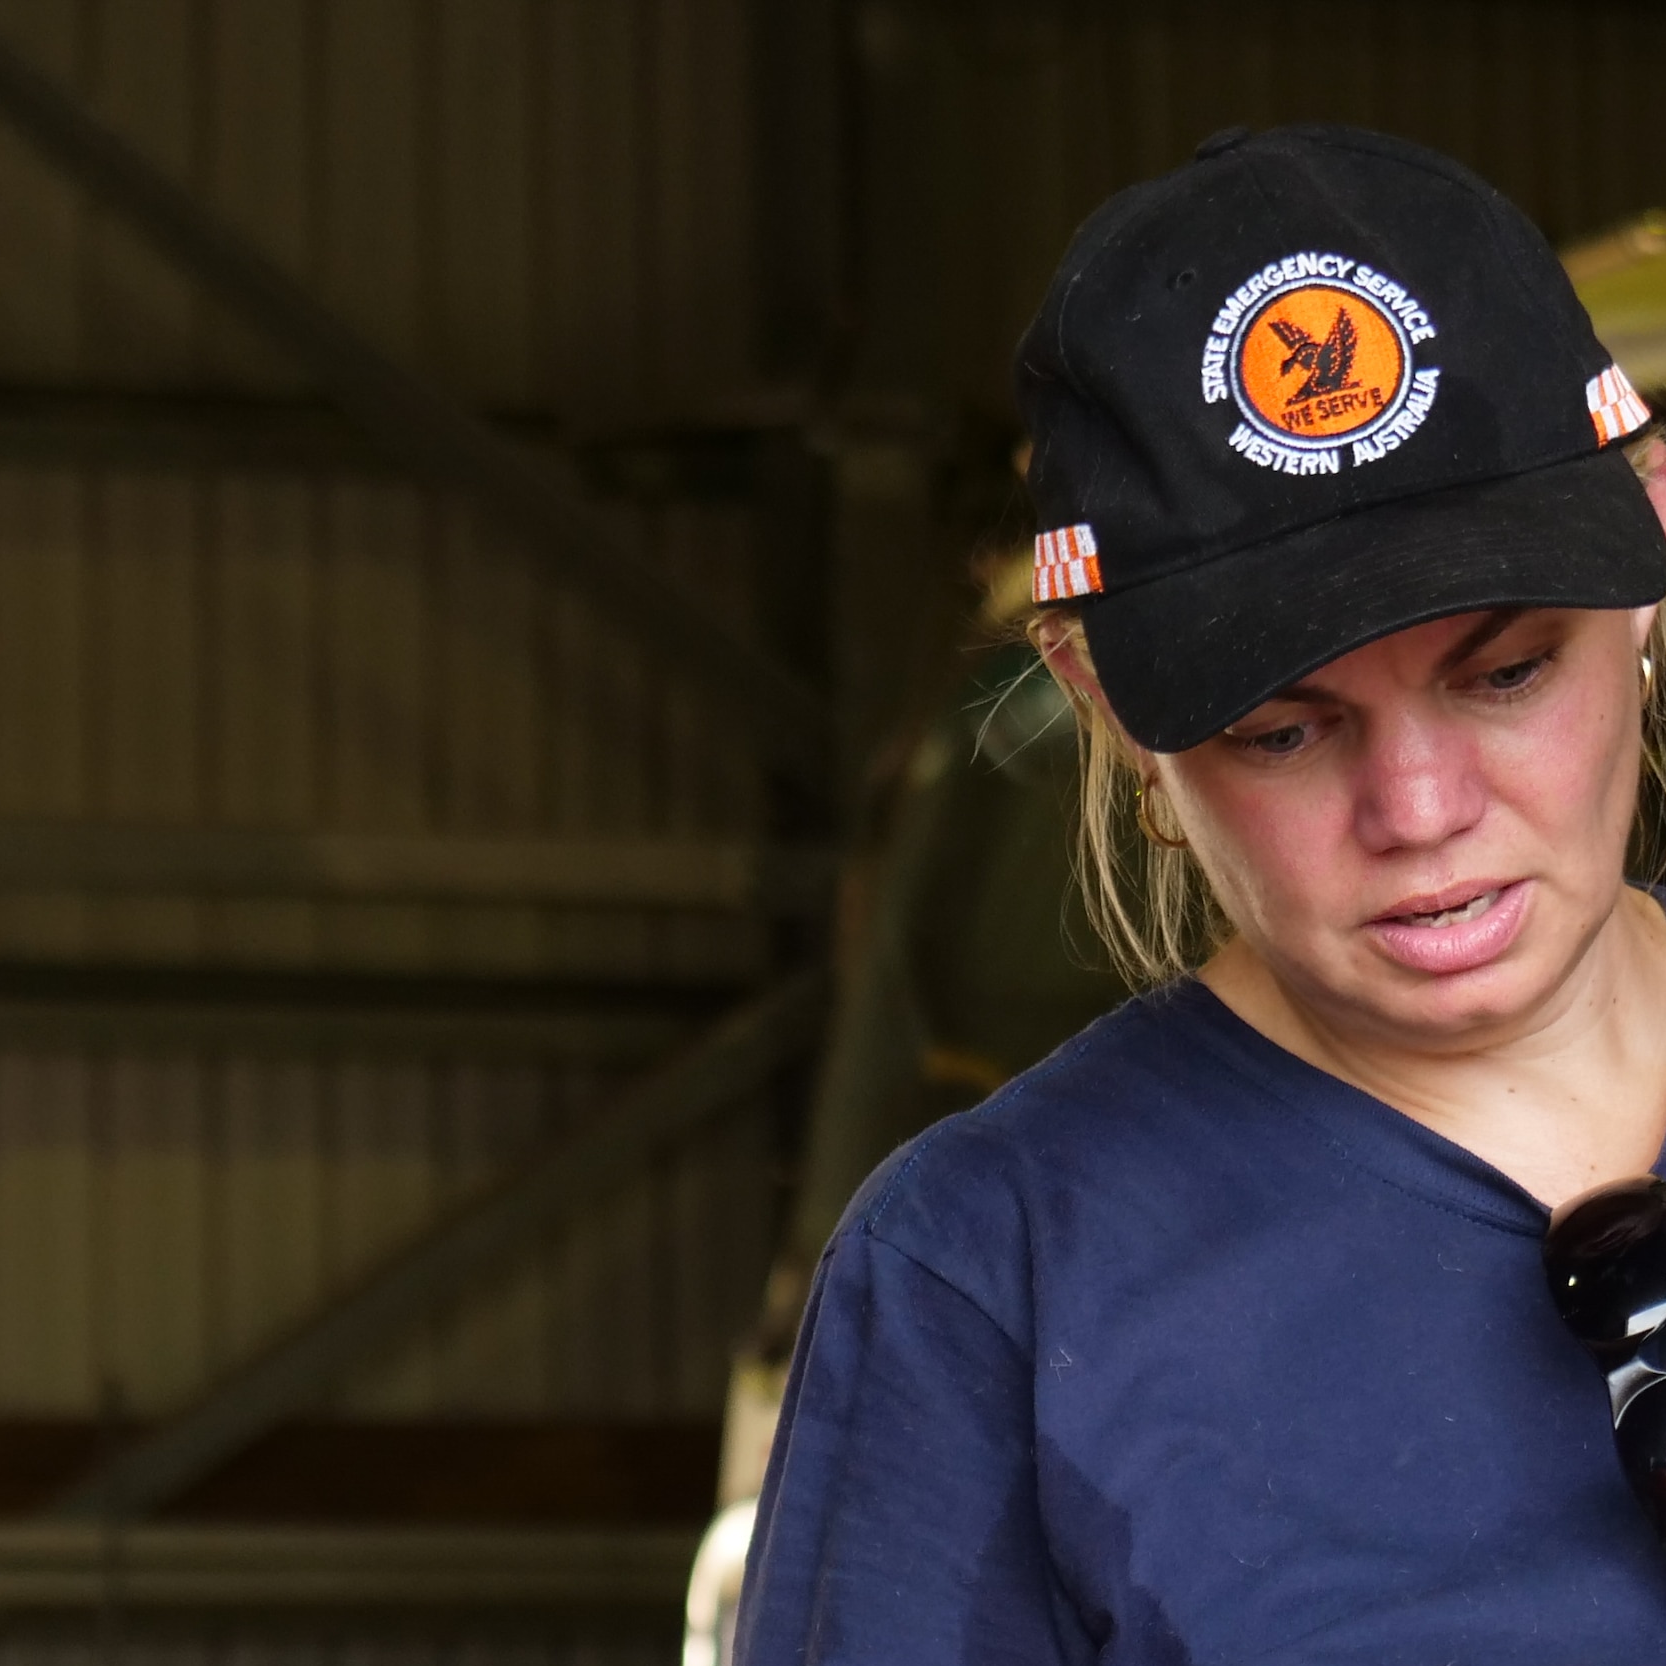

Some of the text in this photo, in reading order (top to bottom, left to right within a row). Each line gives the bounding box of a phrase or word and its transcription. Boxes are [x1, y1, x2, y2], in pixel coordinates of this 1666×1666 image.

[1201, 252, 1436, 403] STATE EMERGENCY SERVICE
[1229, 368, 1441, 475] WESTERN AUSTRALIA
[1281, 388, 1384, 430] WE SERVE
